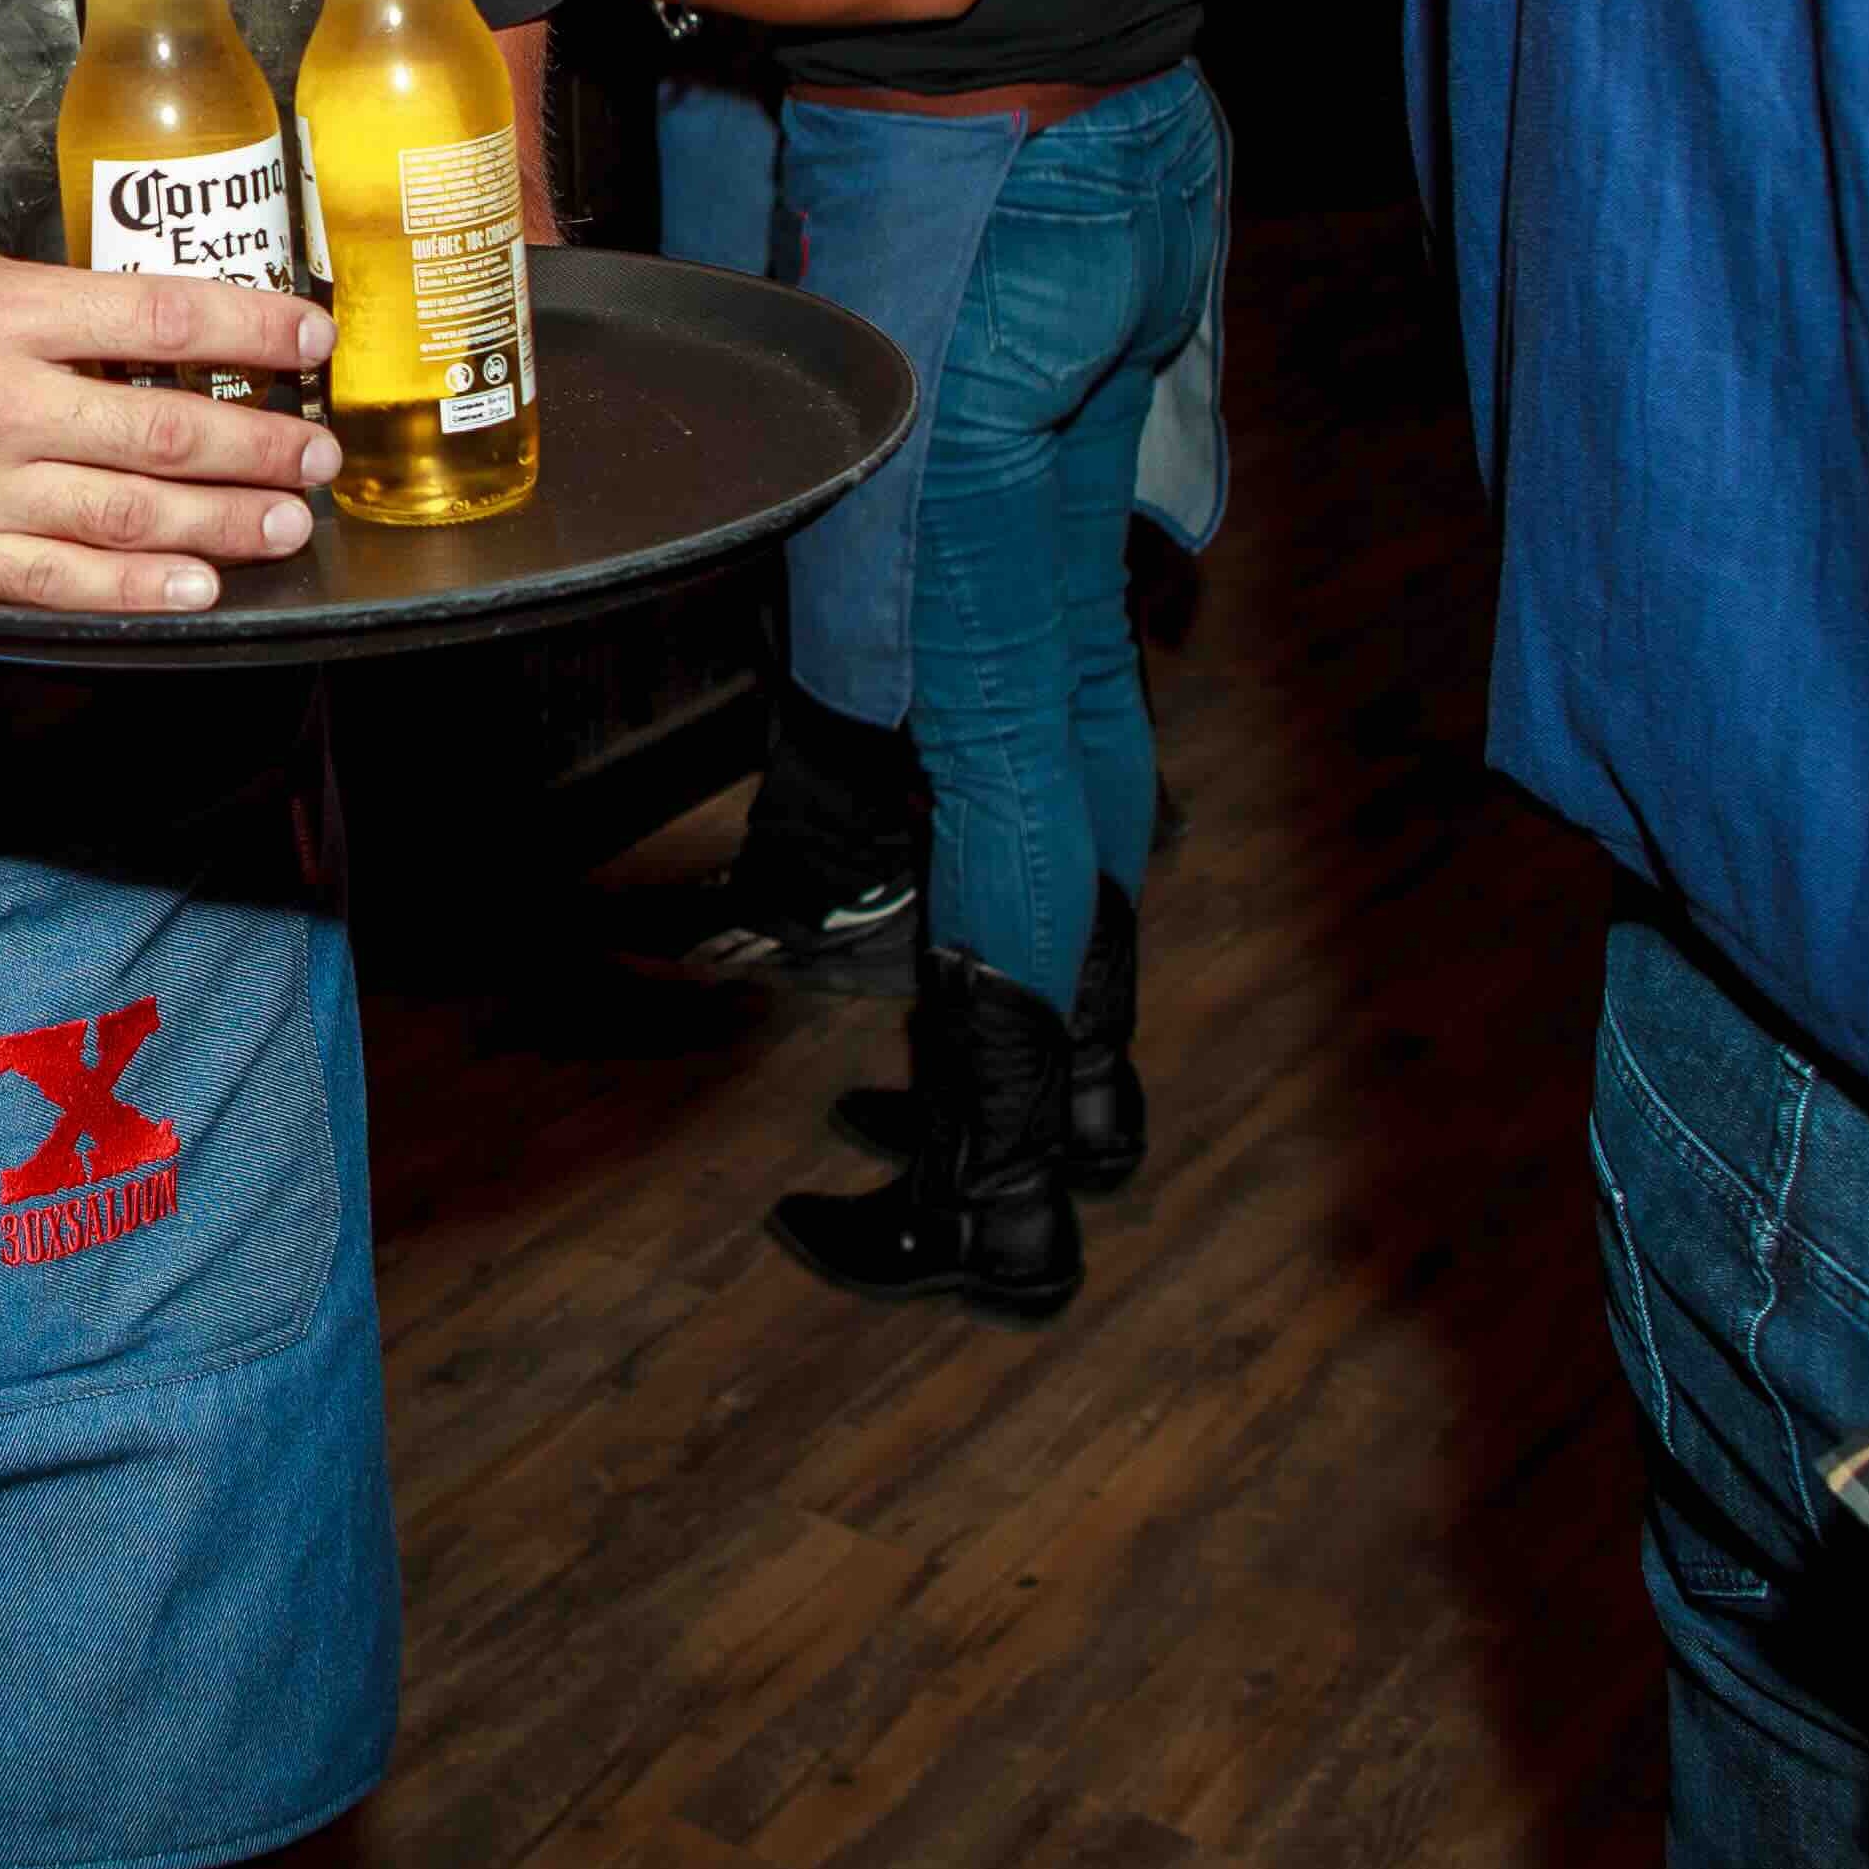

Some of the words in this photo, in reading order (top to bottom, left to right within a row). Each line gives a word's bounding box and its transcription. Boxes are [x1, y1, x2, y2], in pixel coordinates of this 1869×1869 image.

[110, 158, 285, 237] Corona
[170, 226, 269, 265] Extra
[211, 381, 252, 401] FINA
